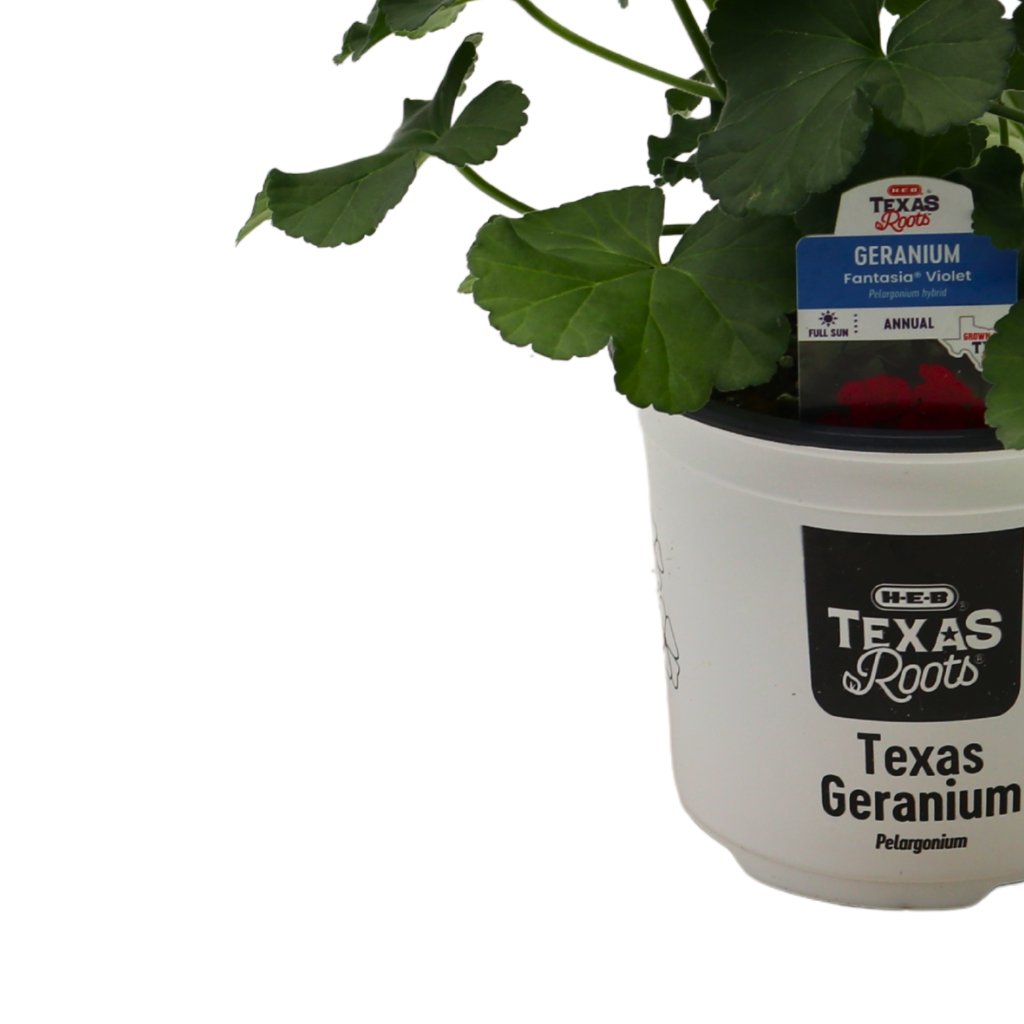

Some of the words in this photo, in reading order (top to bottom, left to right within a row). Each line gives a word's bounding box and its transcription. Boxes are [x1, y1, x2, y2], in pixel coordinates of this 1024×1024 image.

[869, 195, 940, 213] TEXAS
[875, 210, 931, 233] Roots
[854, 244, 961, 265] GERANIUM
[926, 269, 972, 282] Violet
[868, 289, 920, 300] Pelargonium
[921, 288, 948, 299] hybrid
[808, 328, 828, 338] FULL
[830, 328, 849, 337] SUN
[883, 317, 935, 330] ANNUAL
[880, 589, 950, 606] H-E-B
[827, 607, 1003, 653] TEXAS
[857, 732, 984, 776] Texas
[821, 774, 1021, 822] Geranium
[875, 833, 968, 854] Pelargonium
